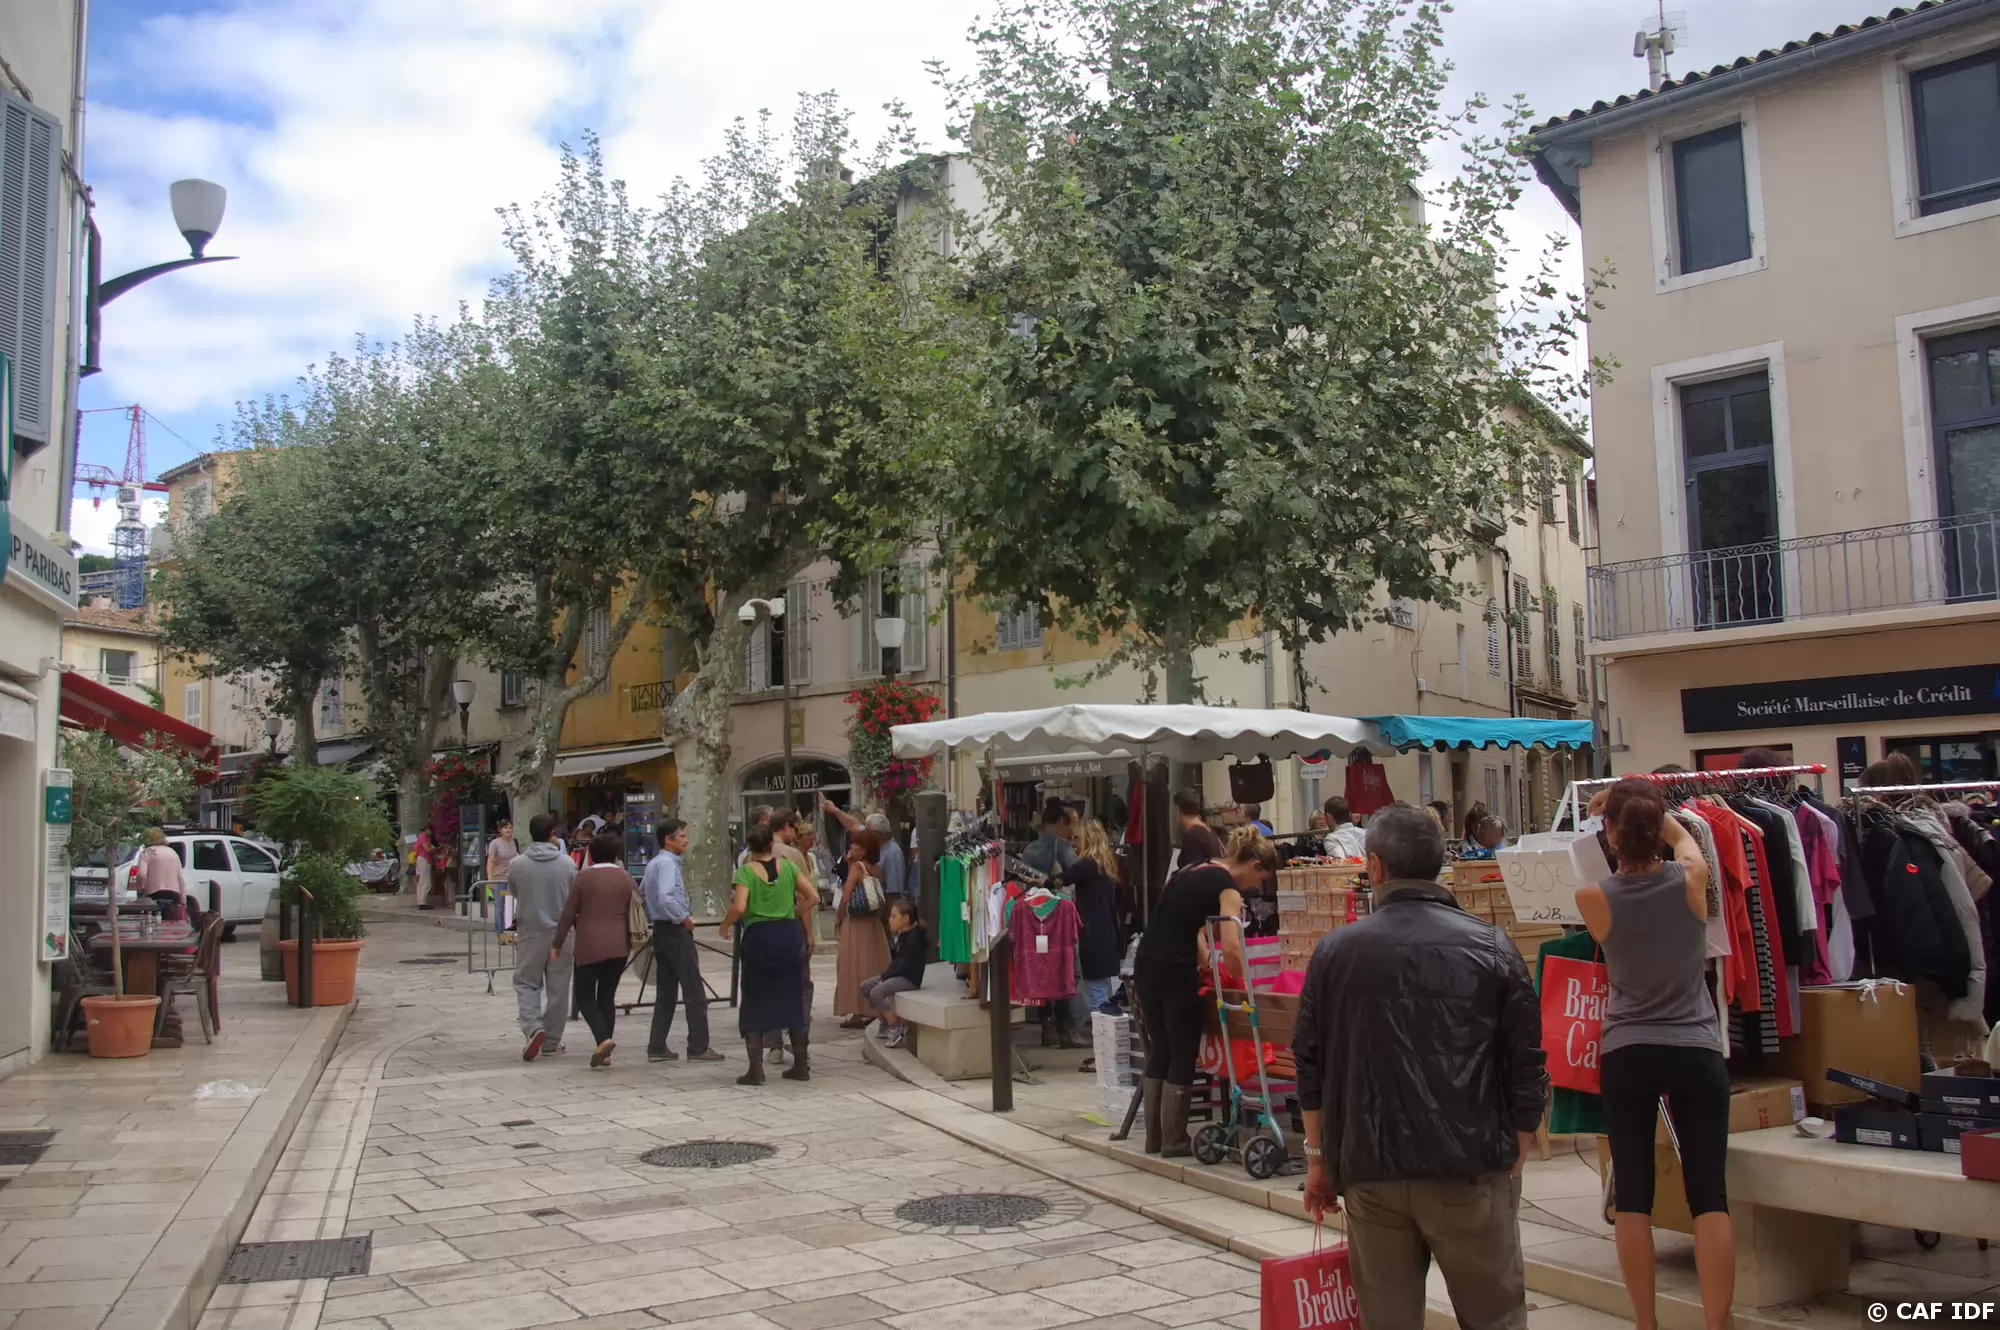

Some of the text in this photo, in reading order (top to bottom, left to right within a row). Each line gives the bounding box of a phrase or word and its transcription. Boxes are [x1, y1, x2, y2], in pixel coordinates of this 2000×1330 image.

[25, 542, 71, 595] PARIBAS
[1737, 685, 1972, 717] Société Marseillaise de Crédit
[765, 773, 818, 790] LAVNDE
[1592, 976, 1608, 994] La
[1318, 1268, 1335, 1288] La
[1293, 1268, 1358, 1329] Brade
